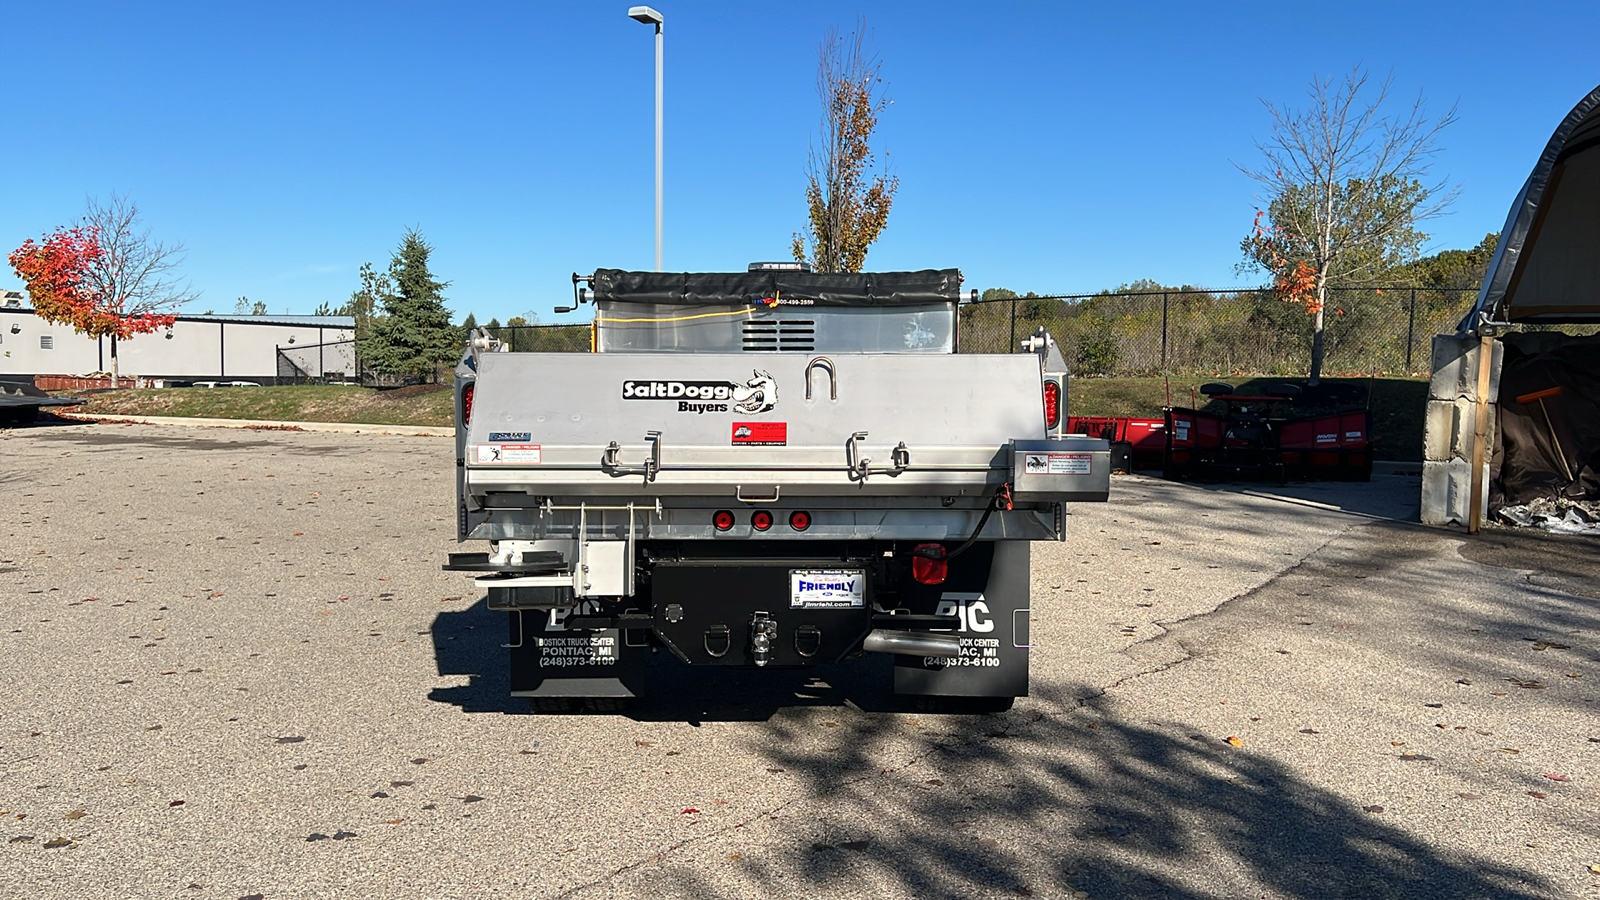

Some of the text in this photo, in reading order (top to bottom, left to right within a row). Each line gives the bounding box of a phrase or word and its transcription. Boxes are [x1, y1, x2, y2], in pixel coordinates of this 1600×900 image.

[623, 381, 731, 399] SaltDogg
[678, 401, 728, 414] Buyers
[799, 580, 856, 592] FRIENDLY
[539, 637, 614, 646] BOSTICK TRUCK CENTER
[973, 638, 999, 647] CENTER
[542, 647, 612, 657] PONTIAC, MI
[983, 648, 997, 656] MI
[539, 656, 615, 668] (248)373-6100
[923, 656, 1000, 668] (248)373-6100
